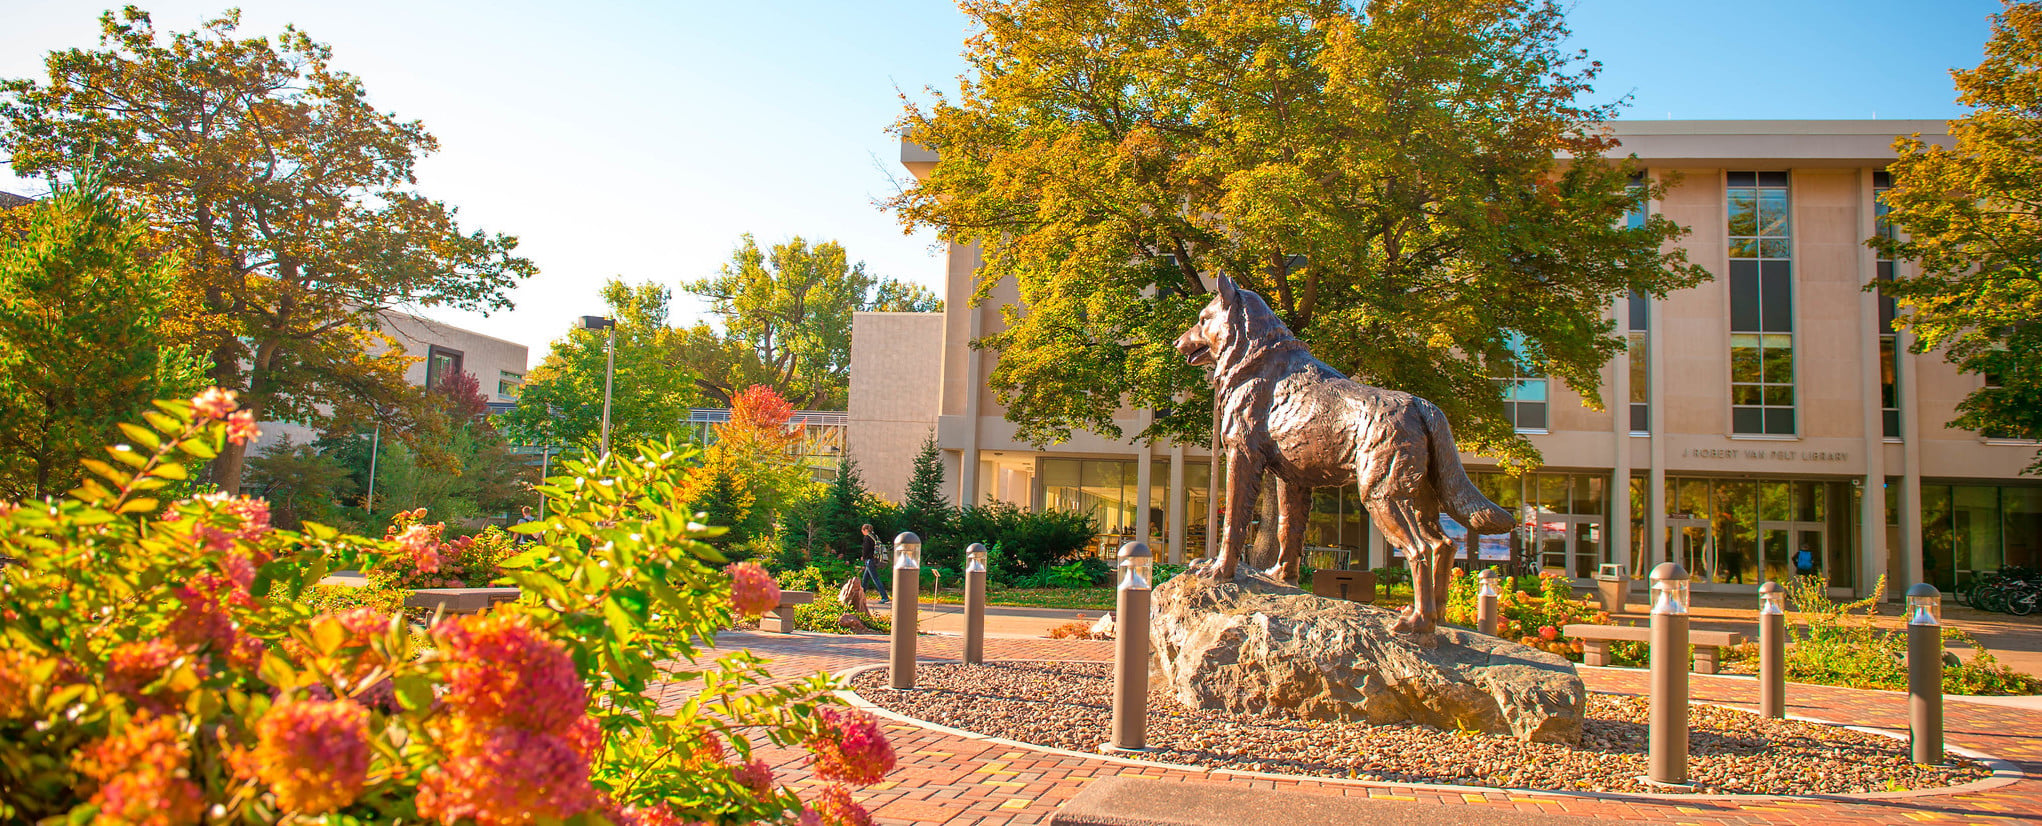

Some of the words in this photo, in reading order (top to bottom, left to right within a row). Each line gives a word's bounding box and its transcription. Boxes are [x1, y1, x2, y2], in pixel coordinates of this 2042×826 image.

[1693, 448, 1738, 460] ROBERT
[1744, 449, 1766, 460] VAN
[1770, 450, 1796, 461] PELT
[1802, 451, 1848, 462] LIBRARY
